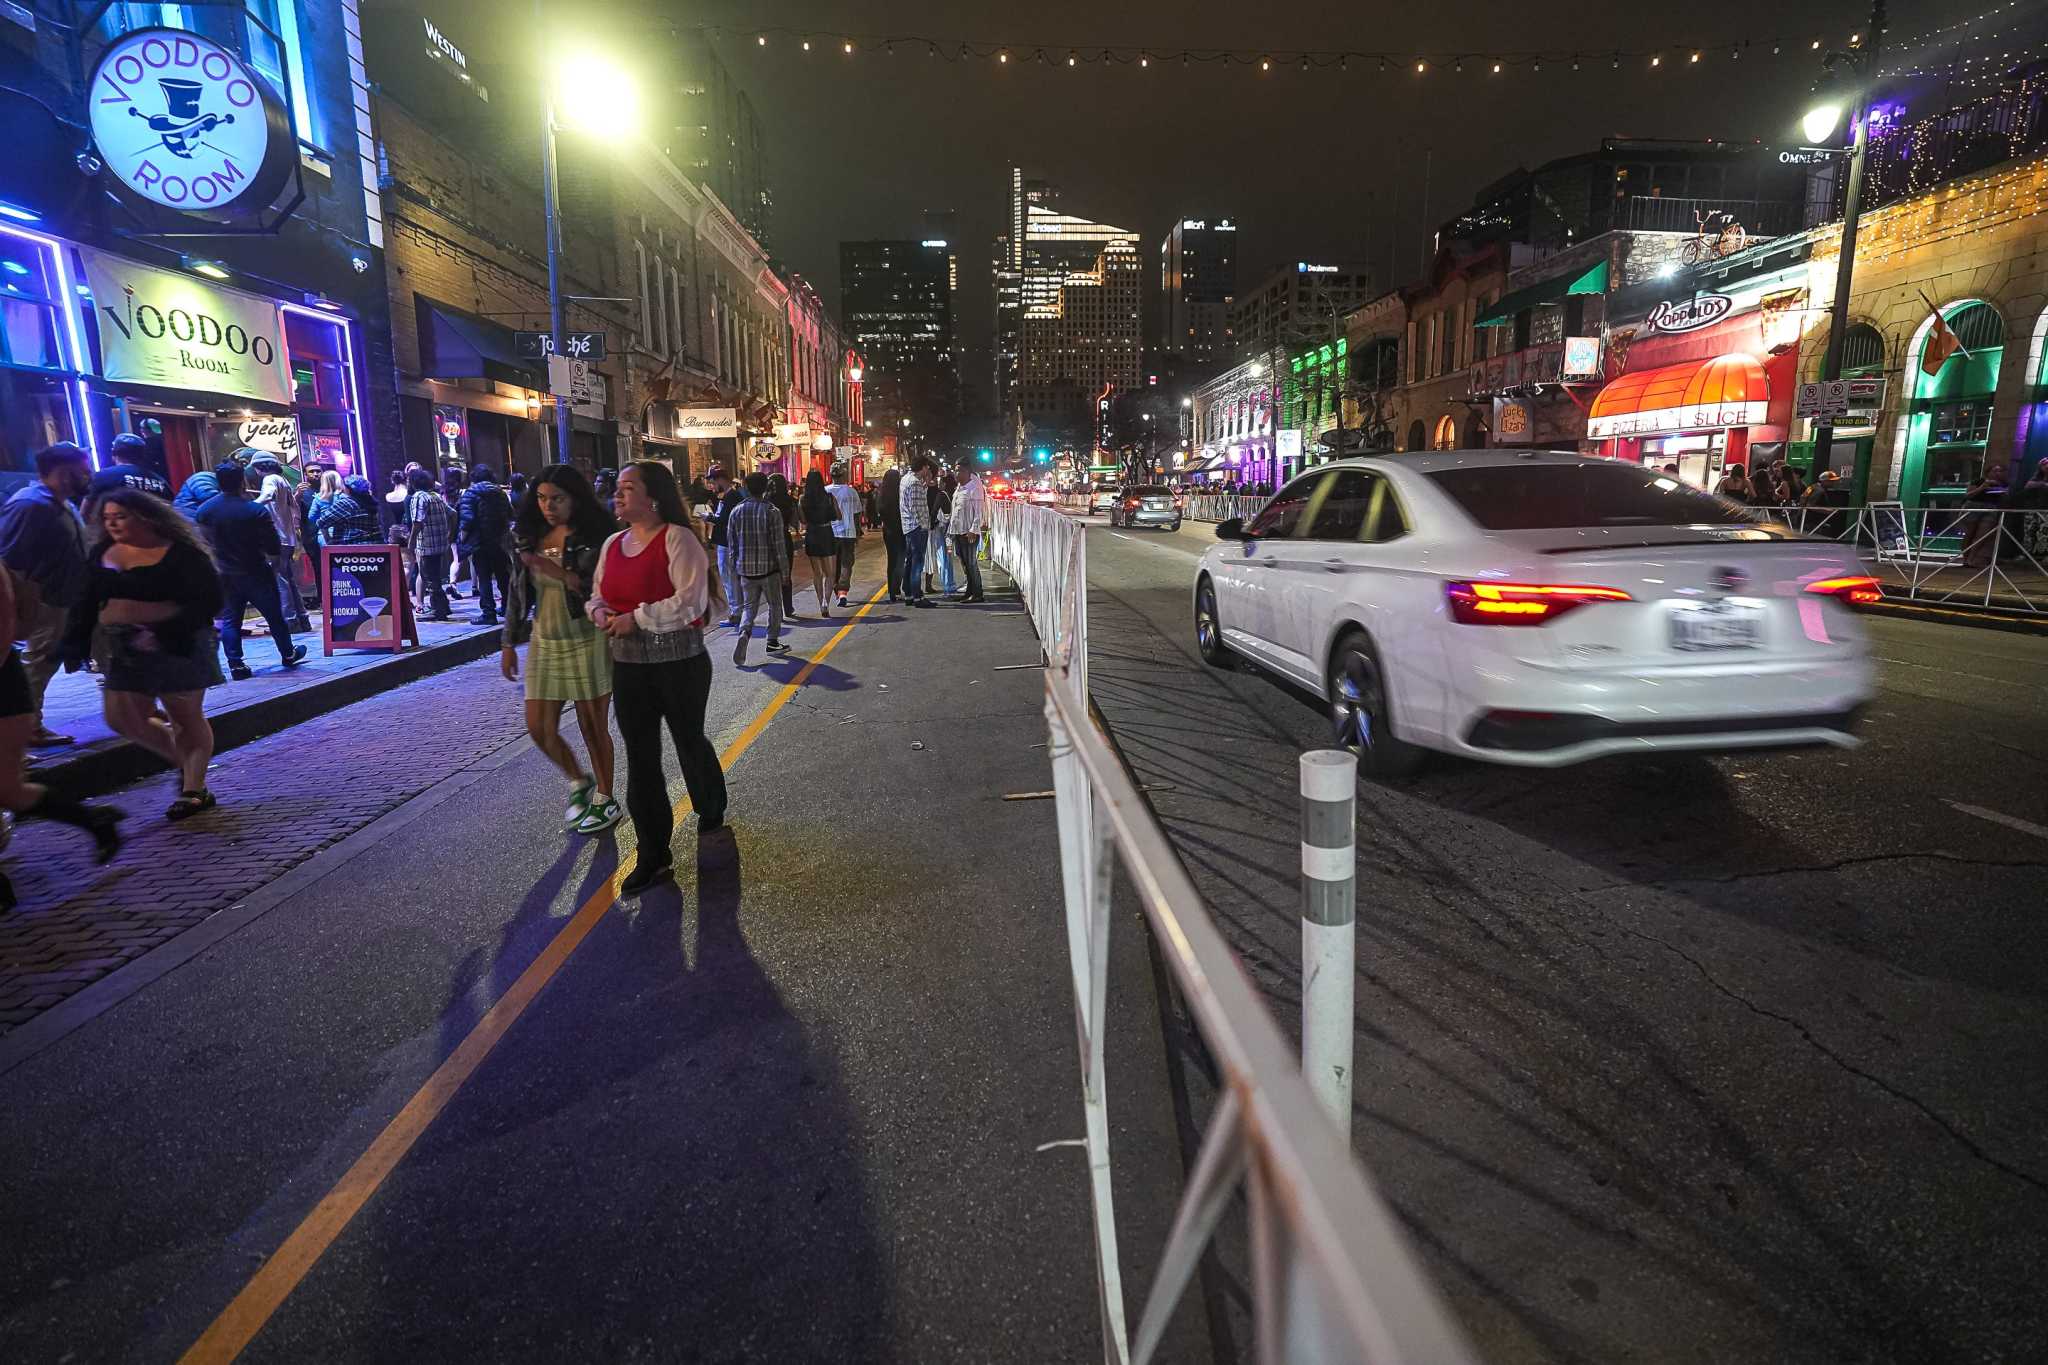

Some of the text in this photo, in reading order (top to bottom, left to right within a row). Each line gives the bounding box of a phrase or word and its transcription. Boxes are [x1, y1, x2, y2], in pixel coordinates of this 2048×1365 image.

[424, 17, 466, 69] WESTIN
[100, 37, 255, 108] VOODOO
[133, 158, 245, 203] ROOM
[102, 284, 274, 365] VOODOO
[1648, 301, 1724, 332] ROPPLO'S
[1694, 410, 1748, 426] SLICE
[244, 421, 294, 443] yeah,
[334, 556, 385, 564] VOODOO
[341, 565, 378, 573] ROOM
[332, 580, 352, 588] DRINK
[332, 588, 361, 597] SPECIALS
[333, 607, 359, 616] HOOKAH
